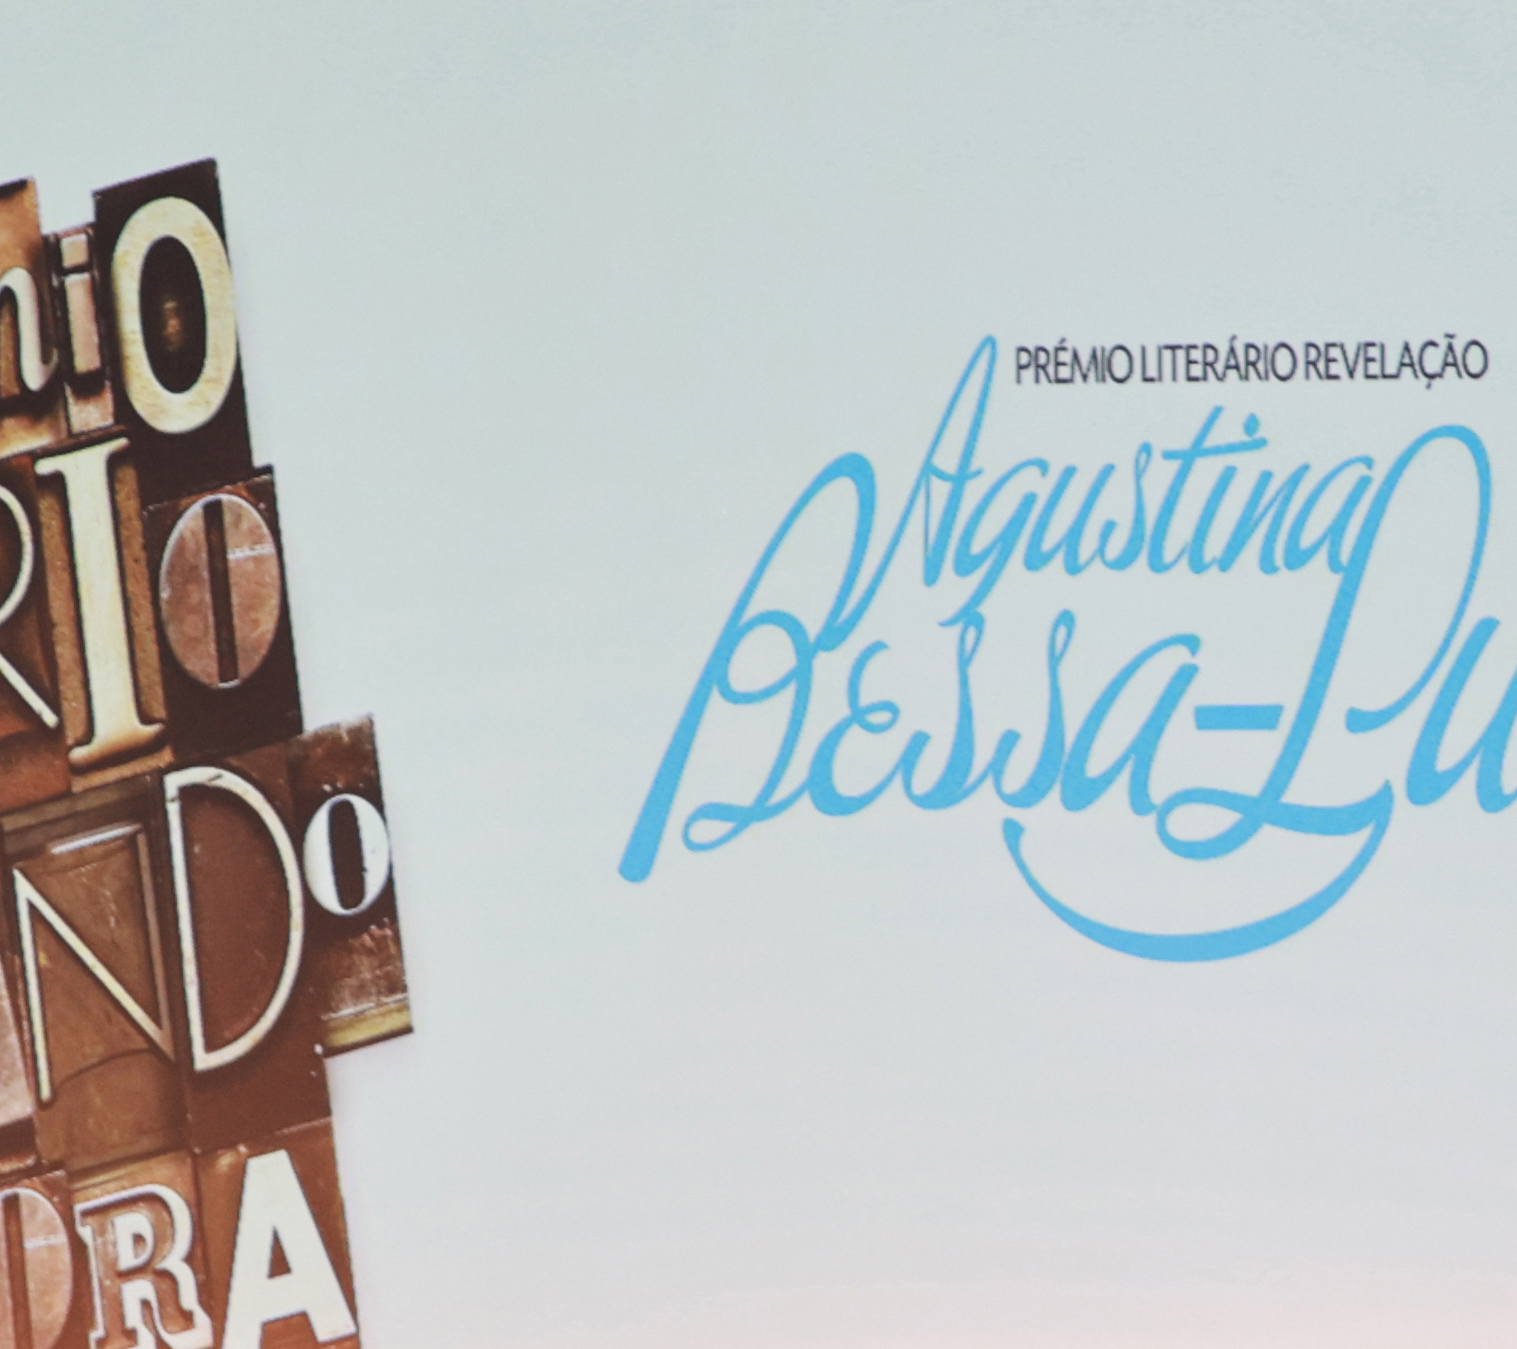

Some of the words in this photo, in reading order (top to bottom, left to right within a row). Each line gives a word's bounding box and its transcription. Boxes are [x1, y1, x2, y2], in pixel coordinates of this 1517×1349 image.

[1015, 333, 1132, 385] PRÉMIO
[1141, 335, 1297, 383] LITERÁRIO
[1303, 333, 1490, 389] REVELAÇÃO
[817, 334, 1375, 630] Agustina
